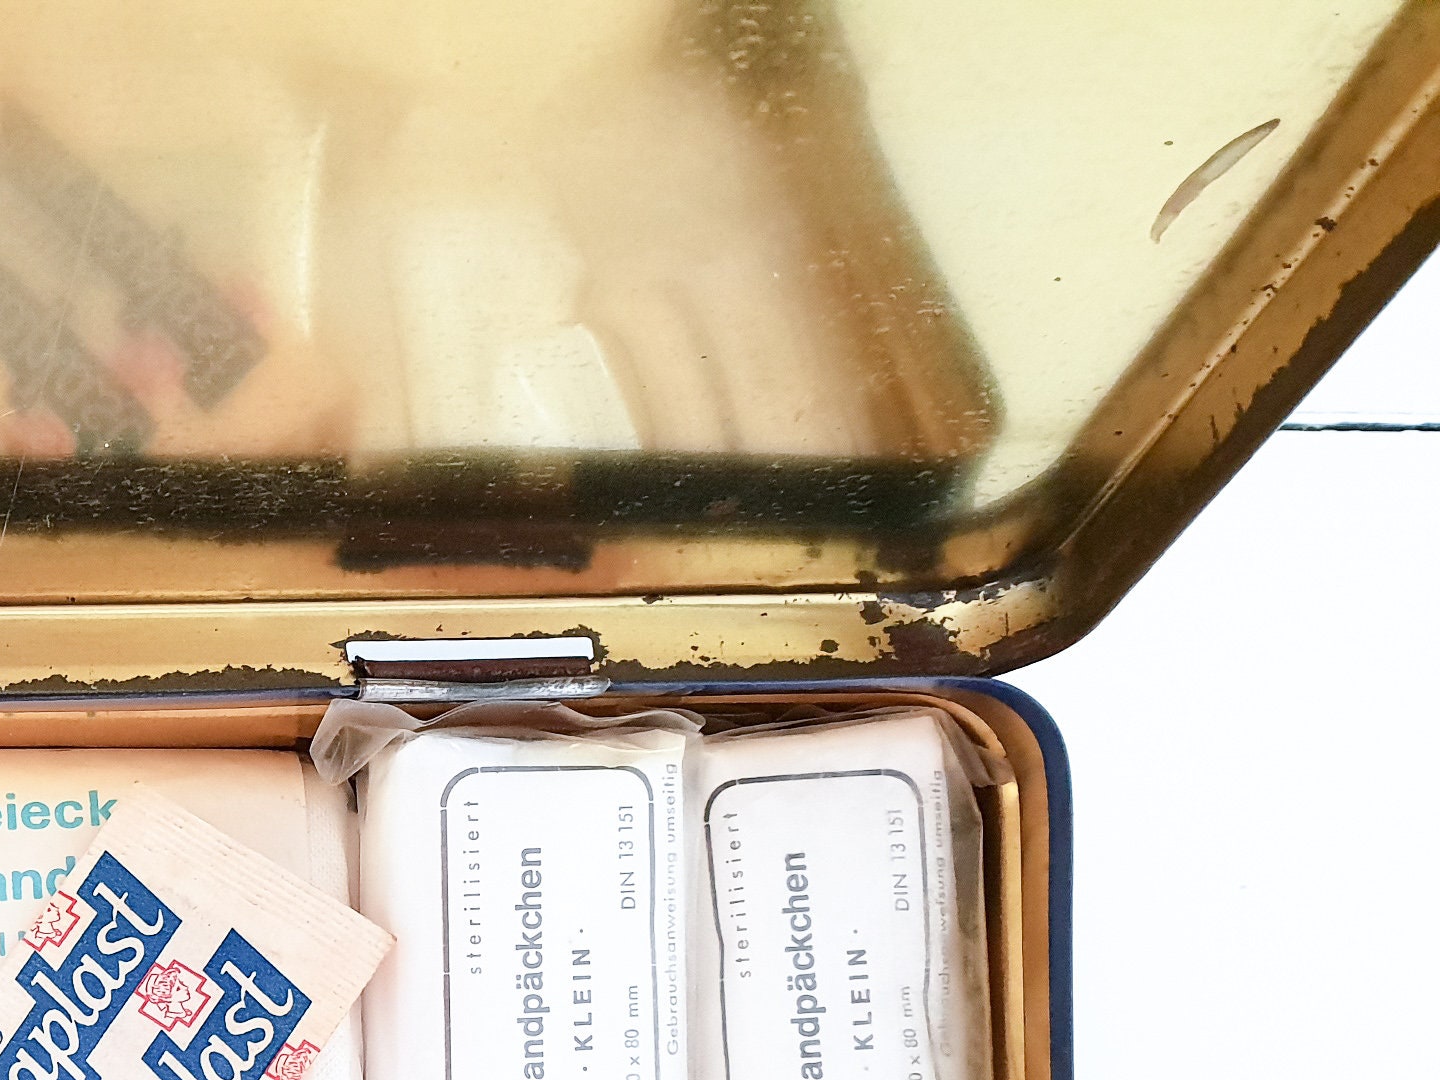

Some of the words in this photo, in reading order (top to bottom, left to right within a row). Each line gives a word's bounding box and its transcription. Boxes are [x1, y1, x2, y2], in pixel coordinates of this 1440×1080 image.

[618, 805, 634, 832] 151
[662, 763, 678, 844] umseitig
[886, 808, 904, 835] 151
[618, 840, 634, 860] 13
[890, 842, 906, 862] 13
[463, 801, 482, 975] sterilisiert
[620, 871, 636, 910] DIN
[723, 812, 752, 978] sterilisiert
[893, 873, 910, 911] DIN
[664, 852, 679, 1056] Gebrauchsanweisung
[572, 949, 593, 1051] KLEIN
[628, 985, 638, 1017] mm
[846, 949, 874, 1051] KLEIN
[900, 986, 913, 1018] mm
[624, 1029, 639, 1049] 80
[902, 1028, 919, 1049] 80
